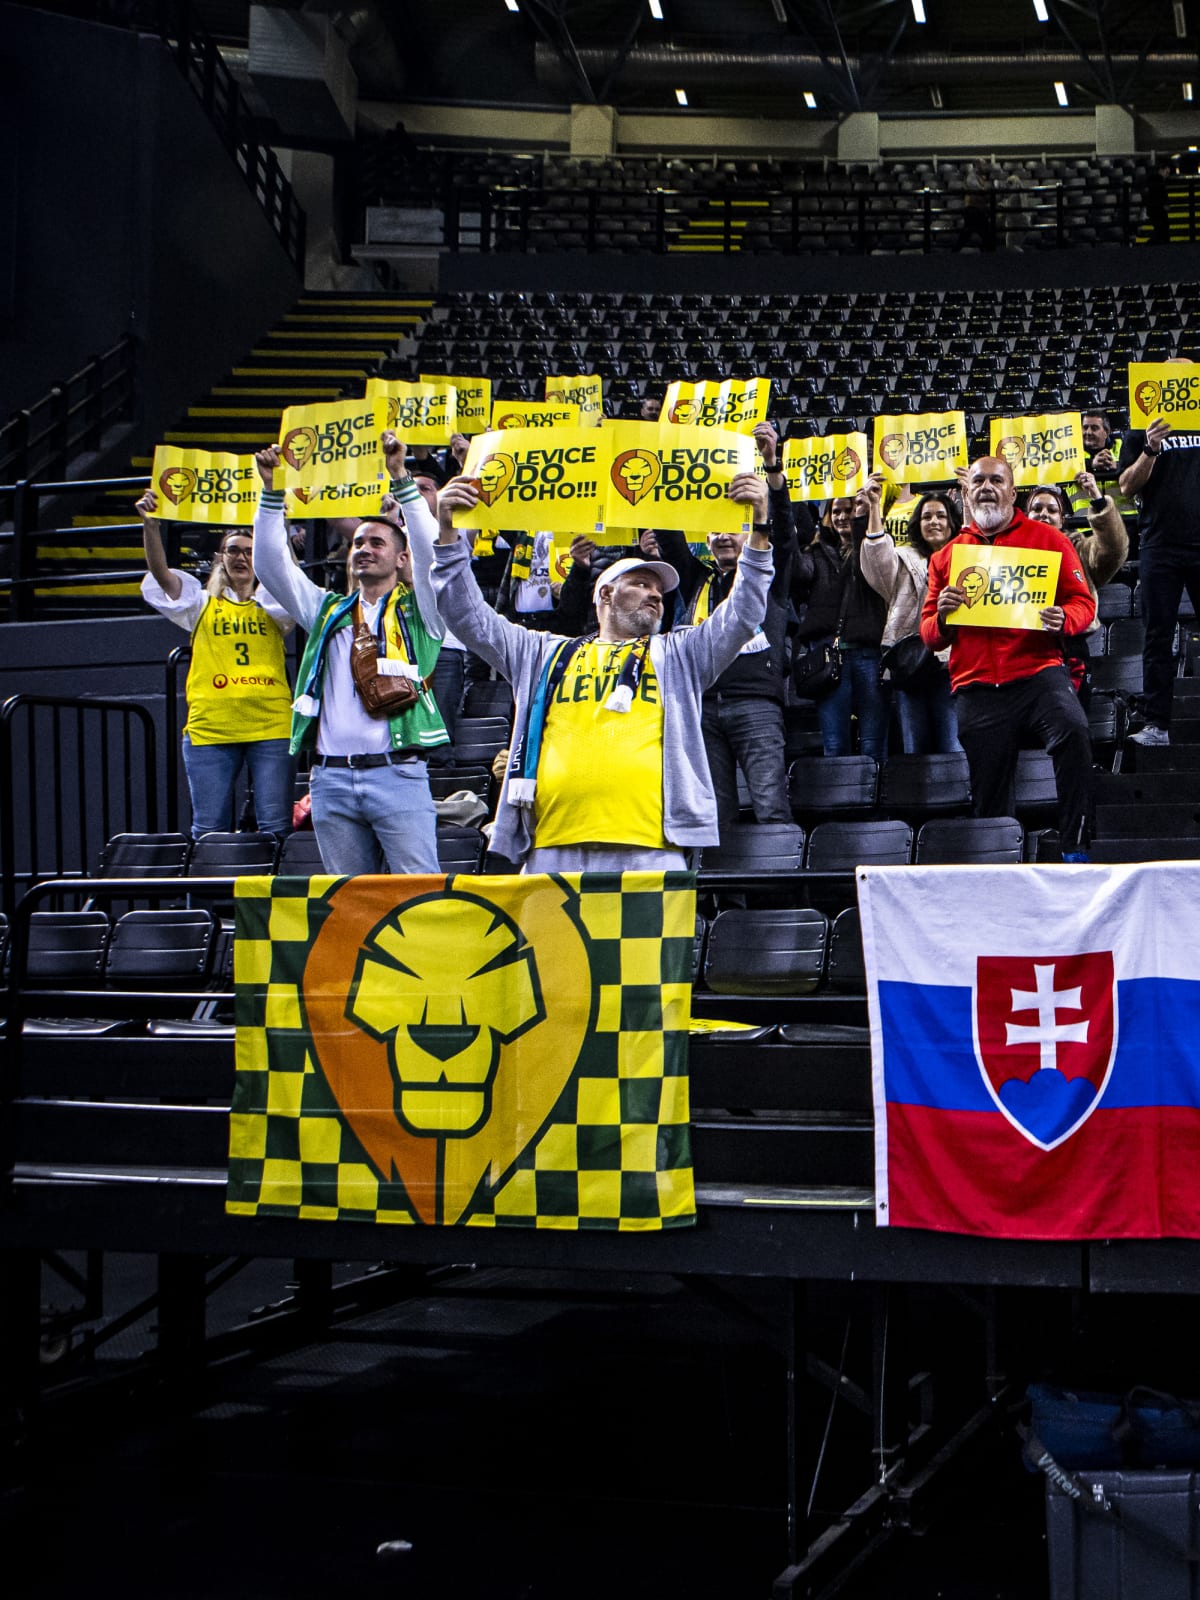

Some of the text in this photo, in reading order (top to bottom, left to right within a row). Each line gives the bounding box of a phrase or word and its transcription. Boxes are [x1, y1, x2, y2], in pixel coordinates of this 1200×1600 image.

[456, 389, 483, 399] VICE
[563, 385, 599, 399] LEVICE
[702, 389, 758, 406] LEVICE
[1161, 387, 1190, 402] DO
[456, 407, 485, 418] HO!!!
[524, 412, 570, 421] LEVICE
[703, 401, 737, 417] DO
[315, 413, 375, 435] LEVICE
[696, 409, 758, 427] TOHO!!!
[318, 430, 353, 452] DO
[907, 424, 956, 441] LEVICE
[1023, 425, 1073, 444] LEVICE
[311, 441, 377, 465] TOHO!!!
[909, 438, 939, 454] DO
[1026, 440, 1056, 457] DO
[514, 446, 596, 466] LEVICE
[658, 448, 738, 465] LEVICE
[905, 446, 960, 465] TOHO!!!
[1022, 447, 1077, 468] TOHO!!!
[194, 468, 254, 481] LEVICE
[515, 463, 564, 486] DO
[662, 462, 711, 485] DO
[197, 477, 233, 493] DO
[319, 484, 381, 501] TOHO!!!
[507, 481, 597, 502] TOHO!!!
[653, 482, 730, 502] TOHO!
[190, 491, 257, 504] TOHO!!!
[988, 565, 1049, 579] LEVICE
[989, 576, 1024, 593] DO
[983, 591, 1047, 606] TOHO!!!
[213, 622, 267, 636] LEVICE
[235, 642, 249, 666] 3
[231, 676, 276, 687] VEOLIA
[556, 673, 657, 704] LEVIE
[1037, 1451, 1081, 1499] Vinten
